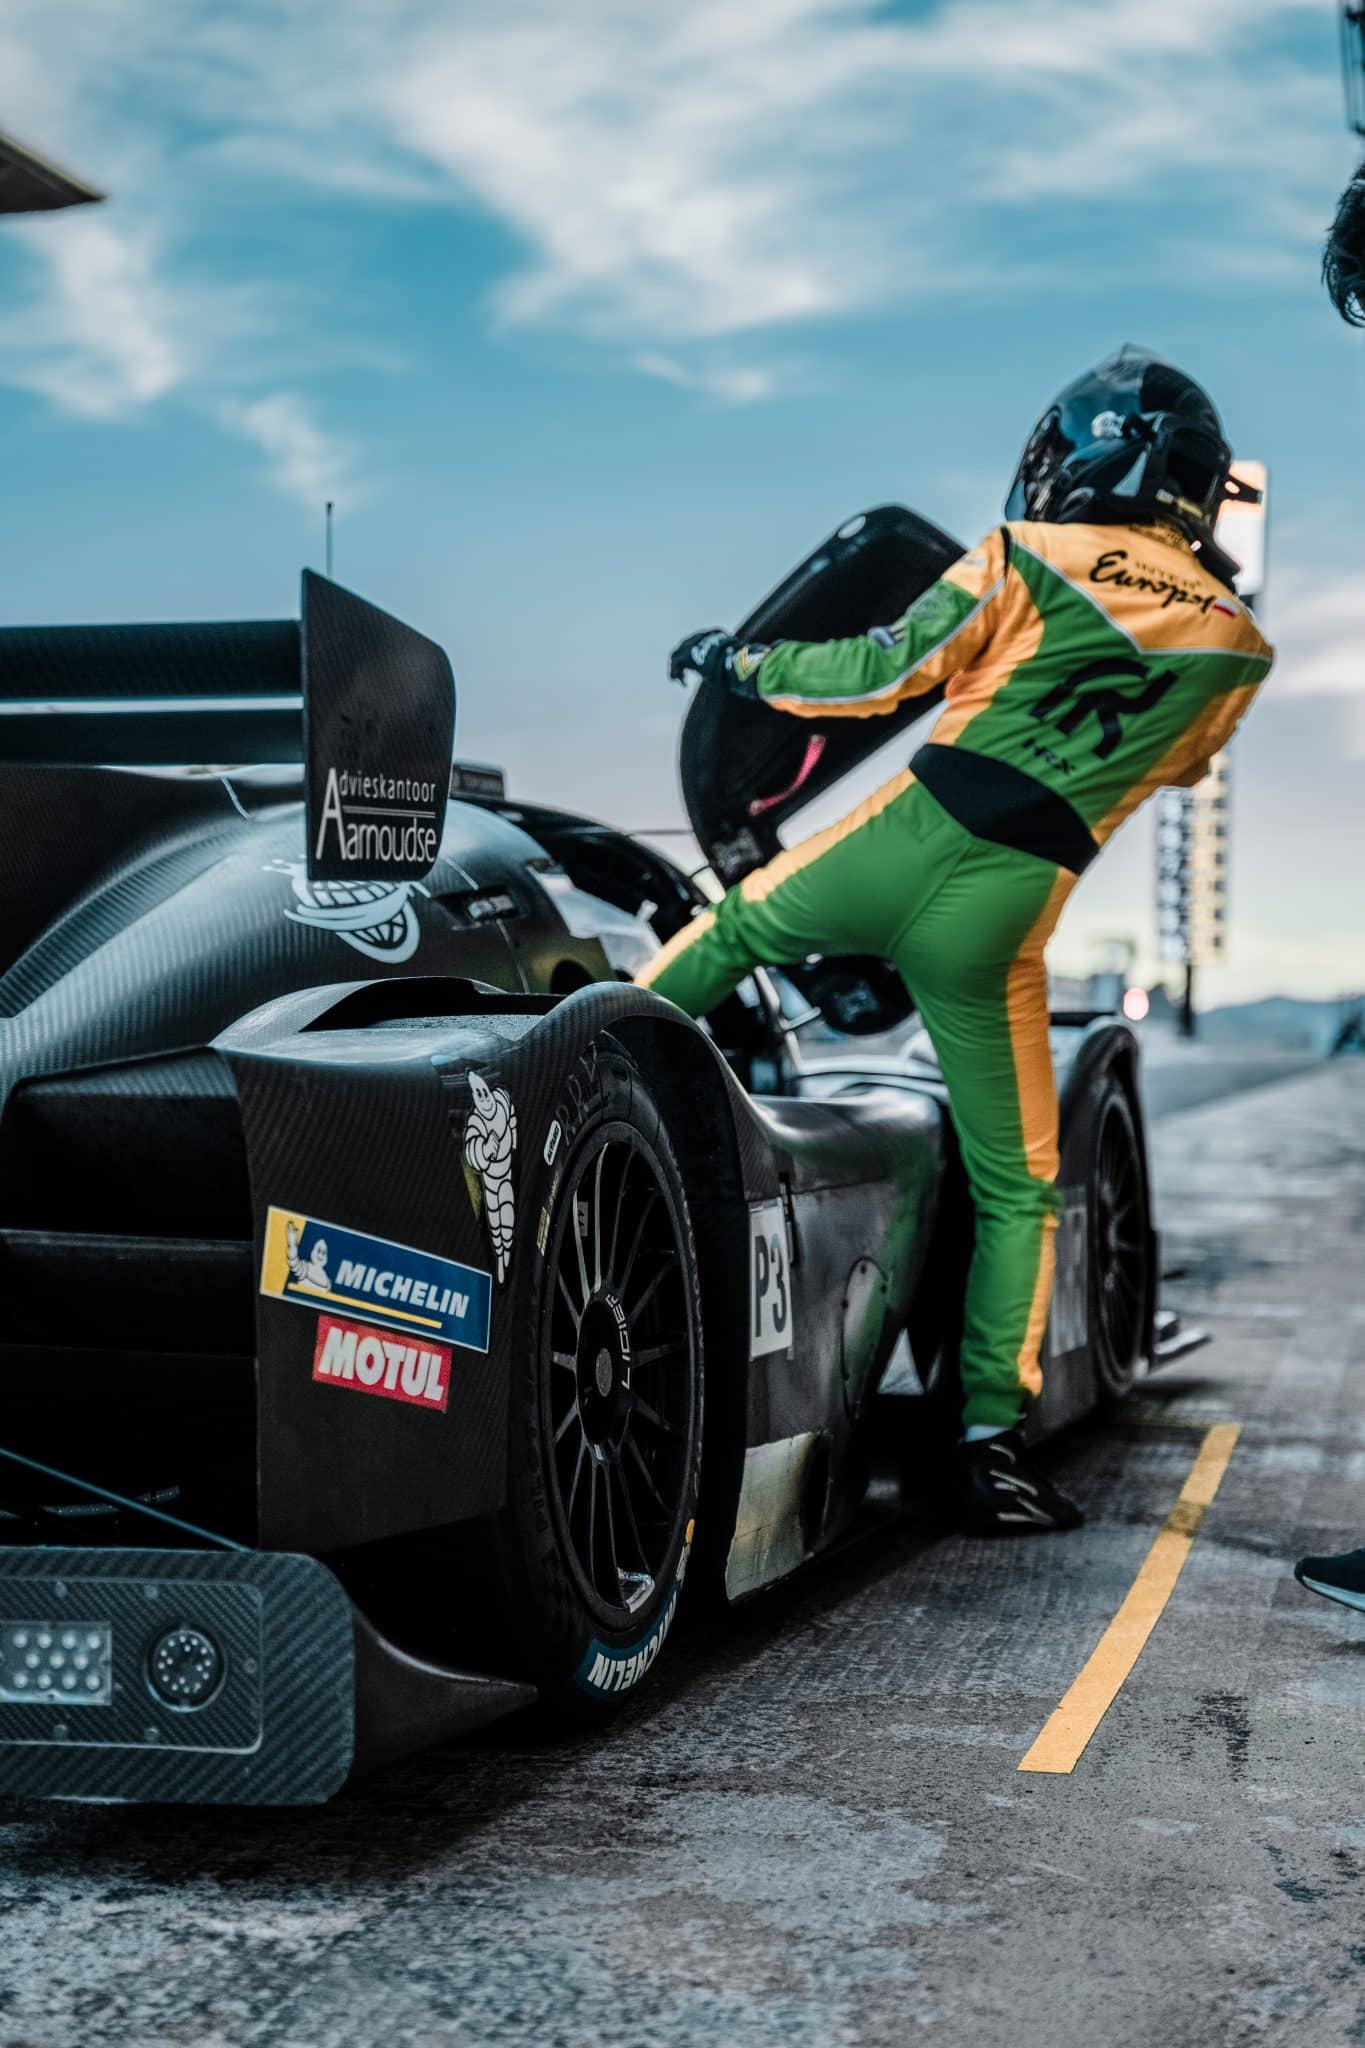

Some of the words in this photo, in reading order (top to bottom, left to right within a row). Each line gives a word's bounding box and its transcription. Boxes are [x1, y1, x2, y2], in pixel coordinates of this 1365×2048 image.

[324, 768, 436, 803] Advieskantoor
[335, 1260, 470, 1319] MICHELIN
[755, 1234, 787, 1338] P3
[318, 1327, 446, 1402] MOTUL
[605, 1293, 632, 1391] LIGIER
[587, 1590, 678, 1692] MICHELIN
